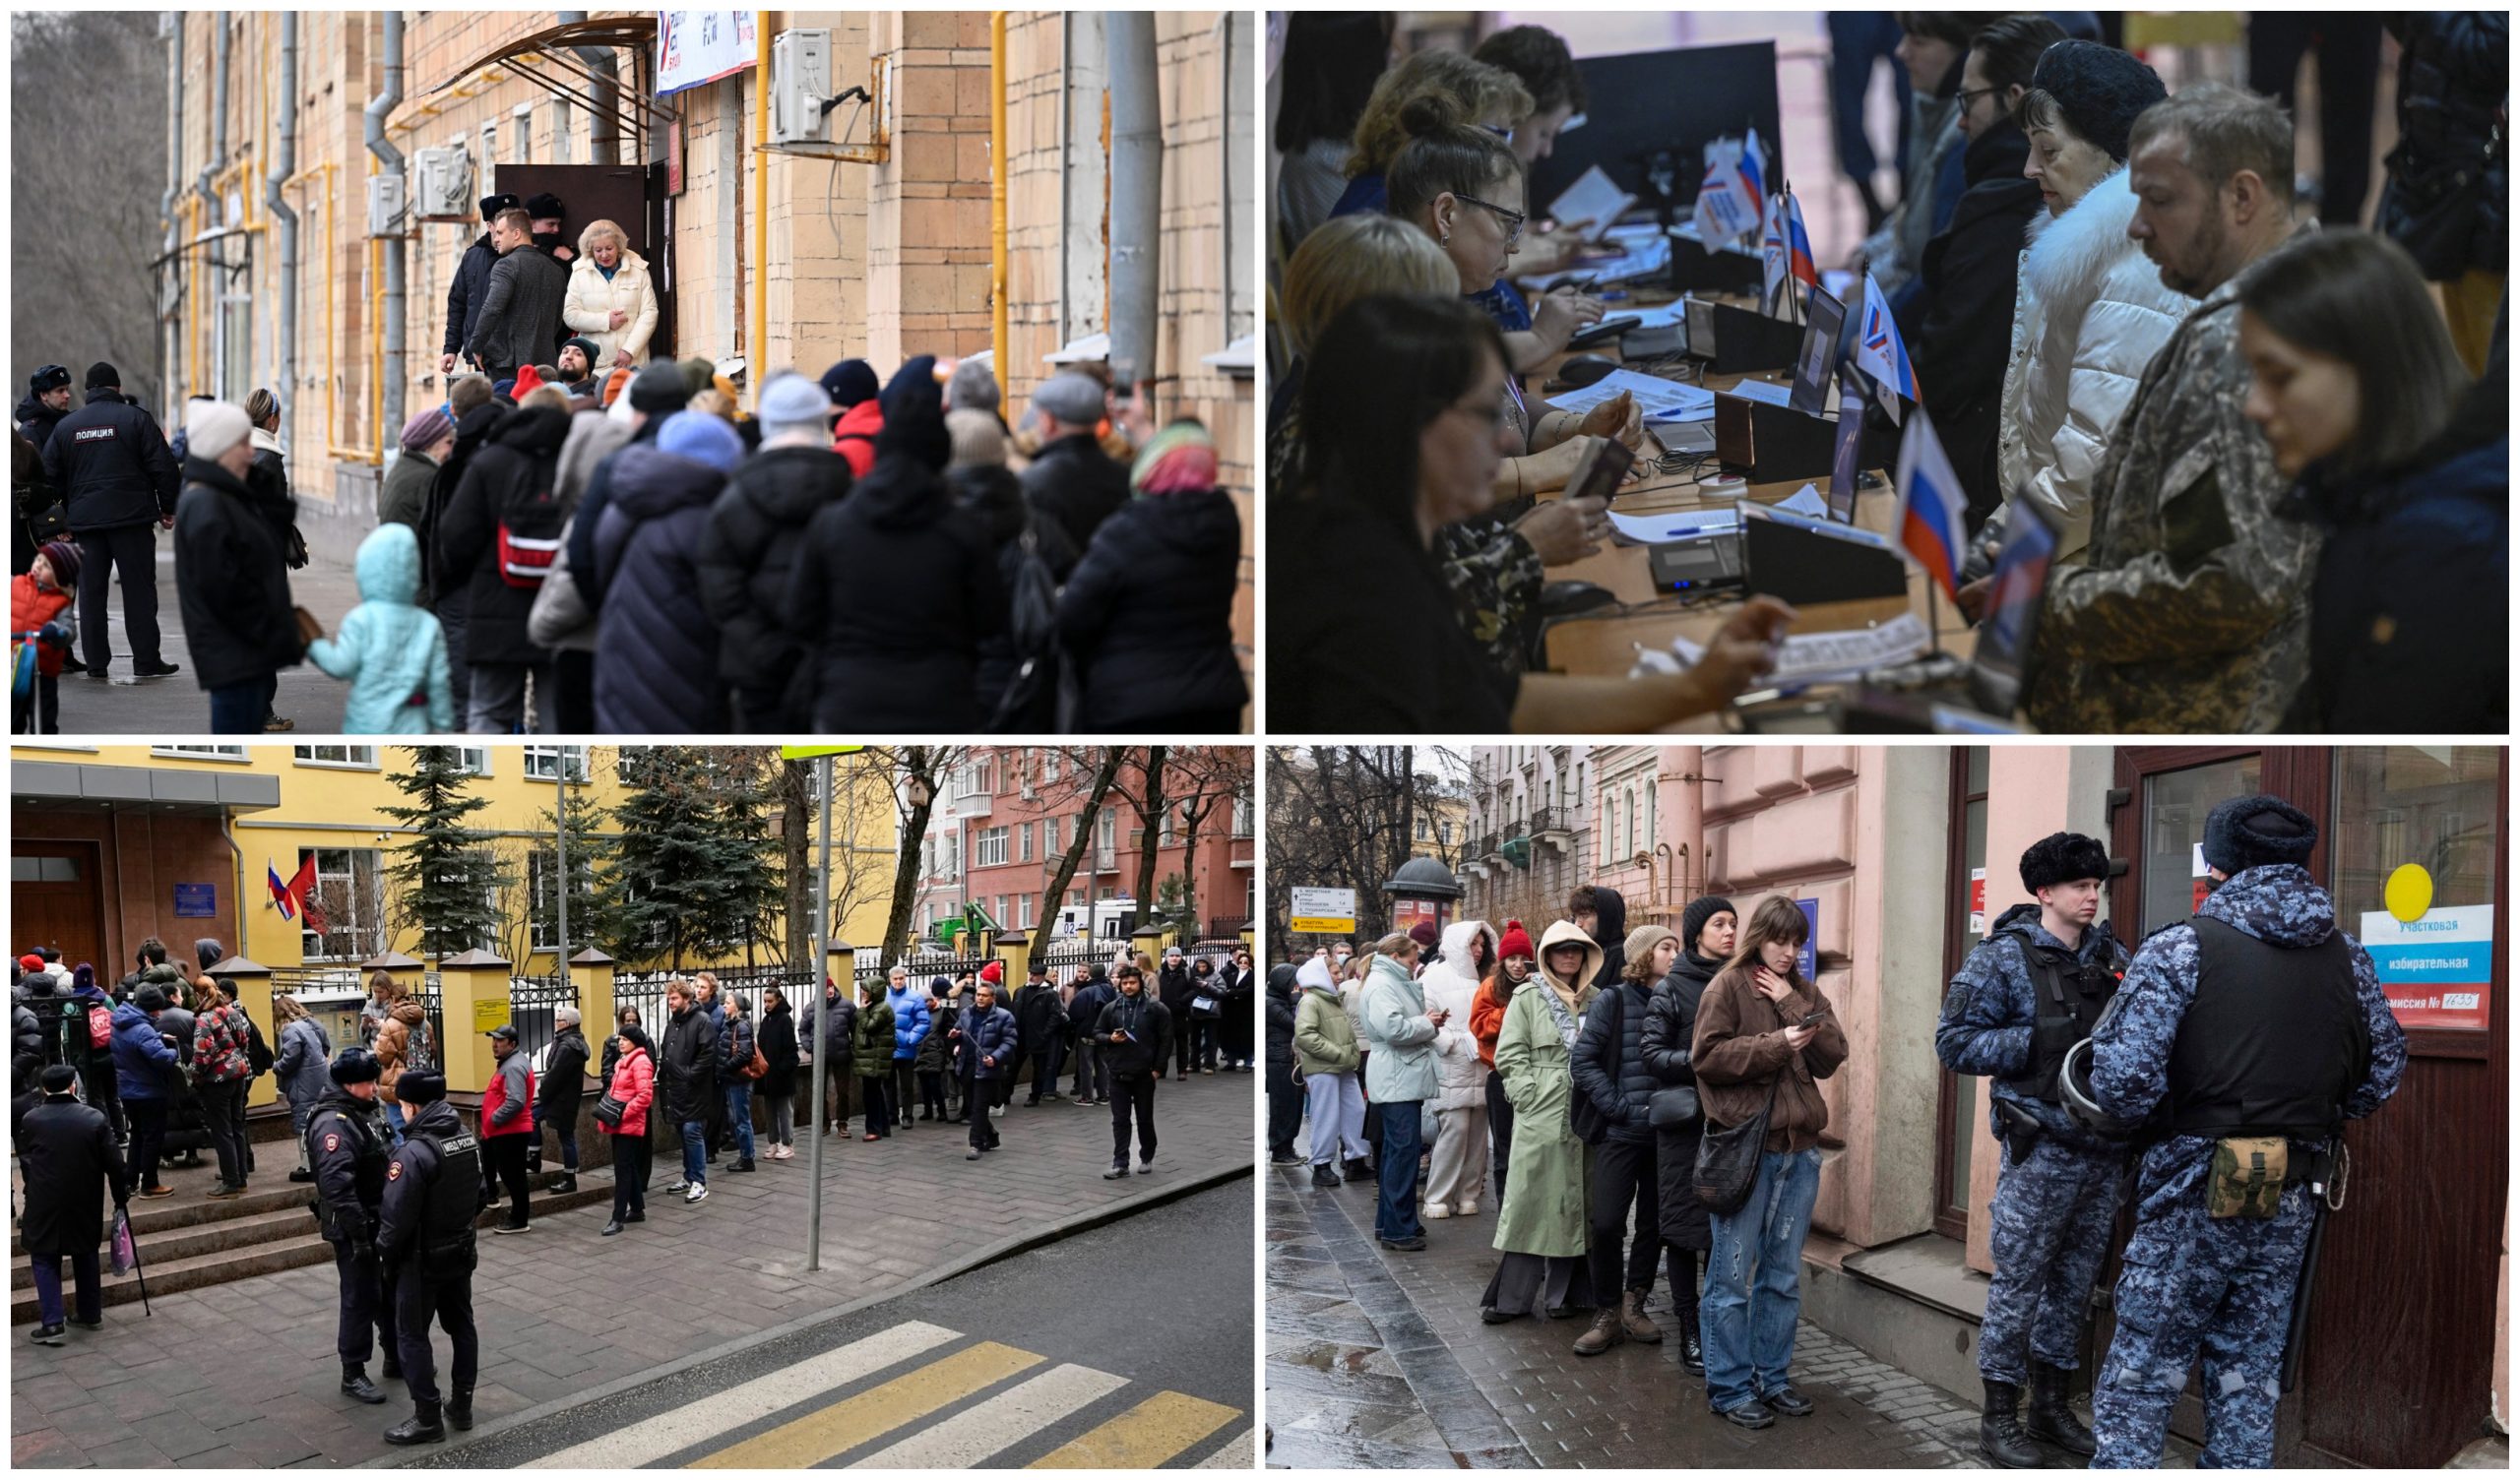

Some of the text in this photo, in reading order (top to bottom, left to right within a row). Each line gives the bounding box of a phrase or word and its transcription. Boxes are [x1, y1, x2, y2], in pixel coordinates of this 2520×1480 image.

[76, 428, 113, 440] ПОЛИЦИЯ
[2399, 920, 2459, 933] Участковая
[2389, 956, 2469, 972] избирательная
[2387, 997, 2427, 1009] миссия
[443, 1141, 460, 1152] МВД
